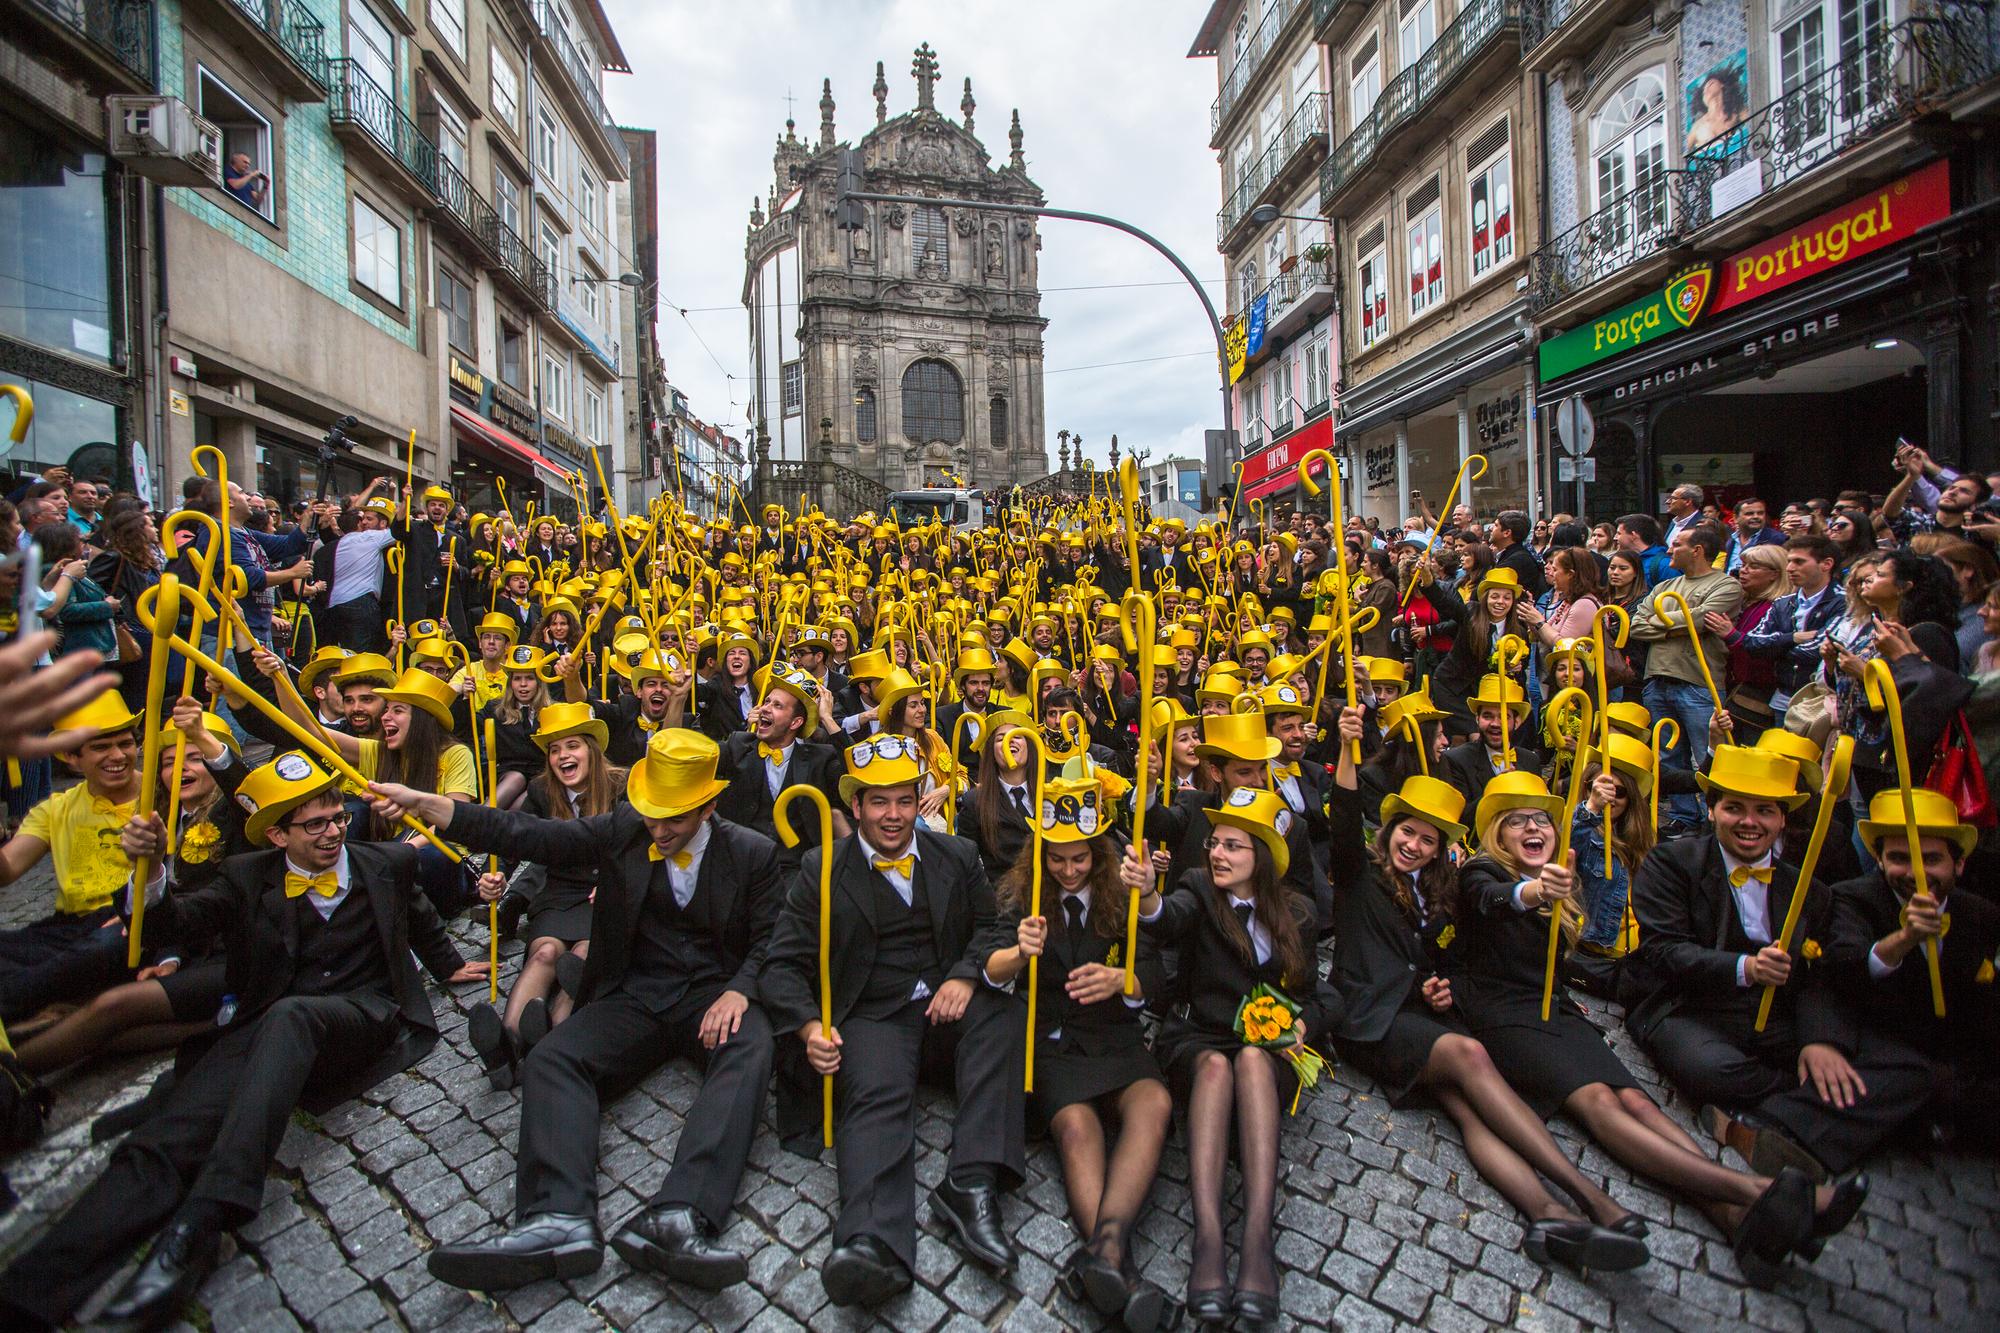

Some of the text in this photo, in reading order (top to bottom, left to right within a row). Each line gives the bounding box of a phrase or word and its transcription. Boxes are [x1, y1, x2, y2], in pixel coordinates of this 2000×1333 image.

[1594, 194, 1894, 352] Força Portugal
[1614, 312, 1841, 400] OFFICIAL STORE
[1476, 390, 1521, 424] flying
[1479, 416, 1519, 444] tiger
[1365, 442, 1395, 467] flying
[1367, 460, 1395, 482] tiger
